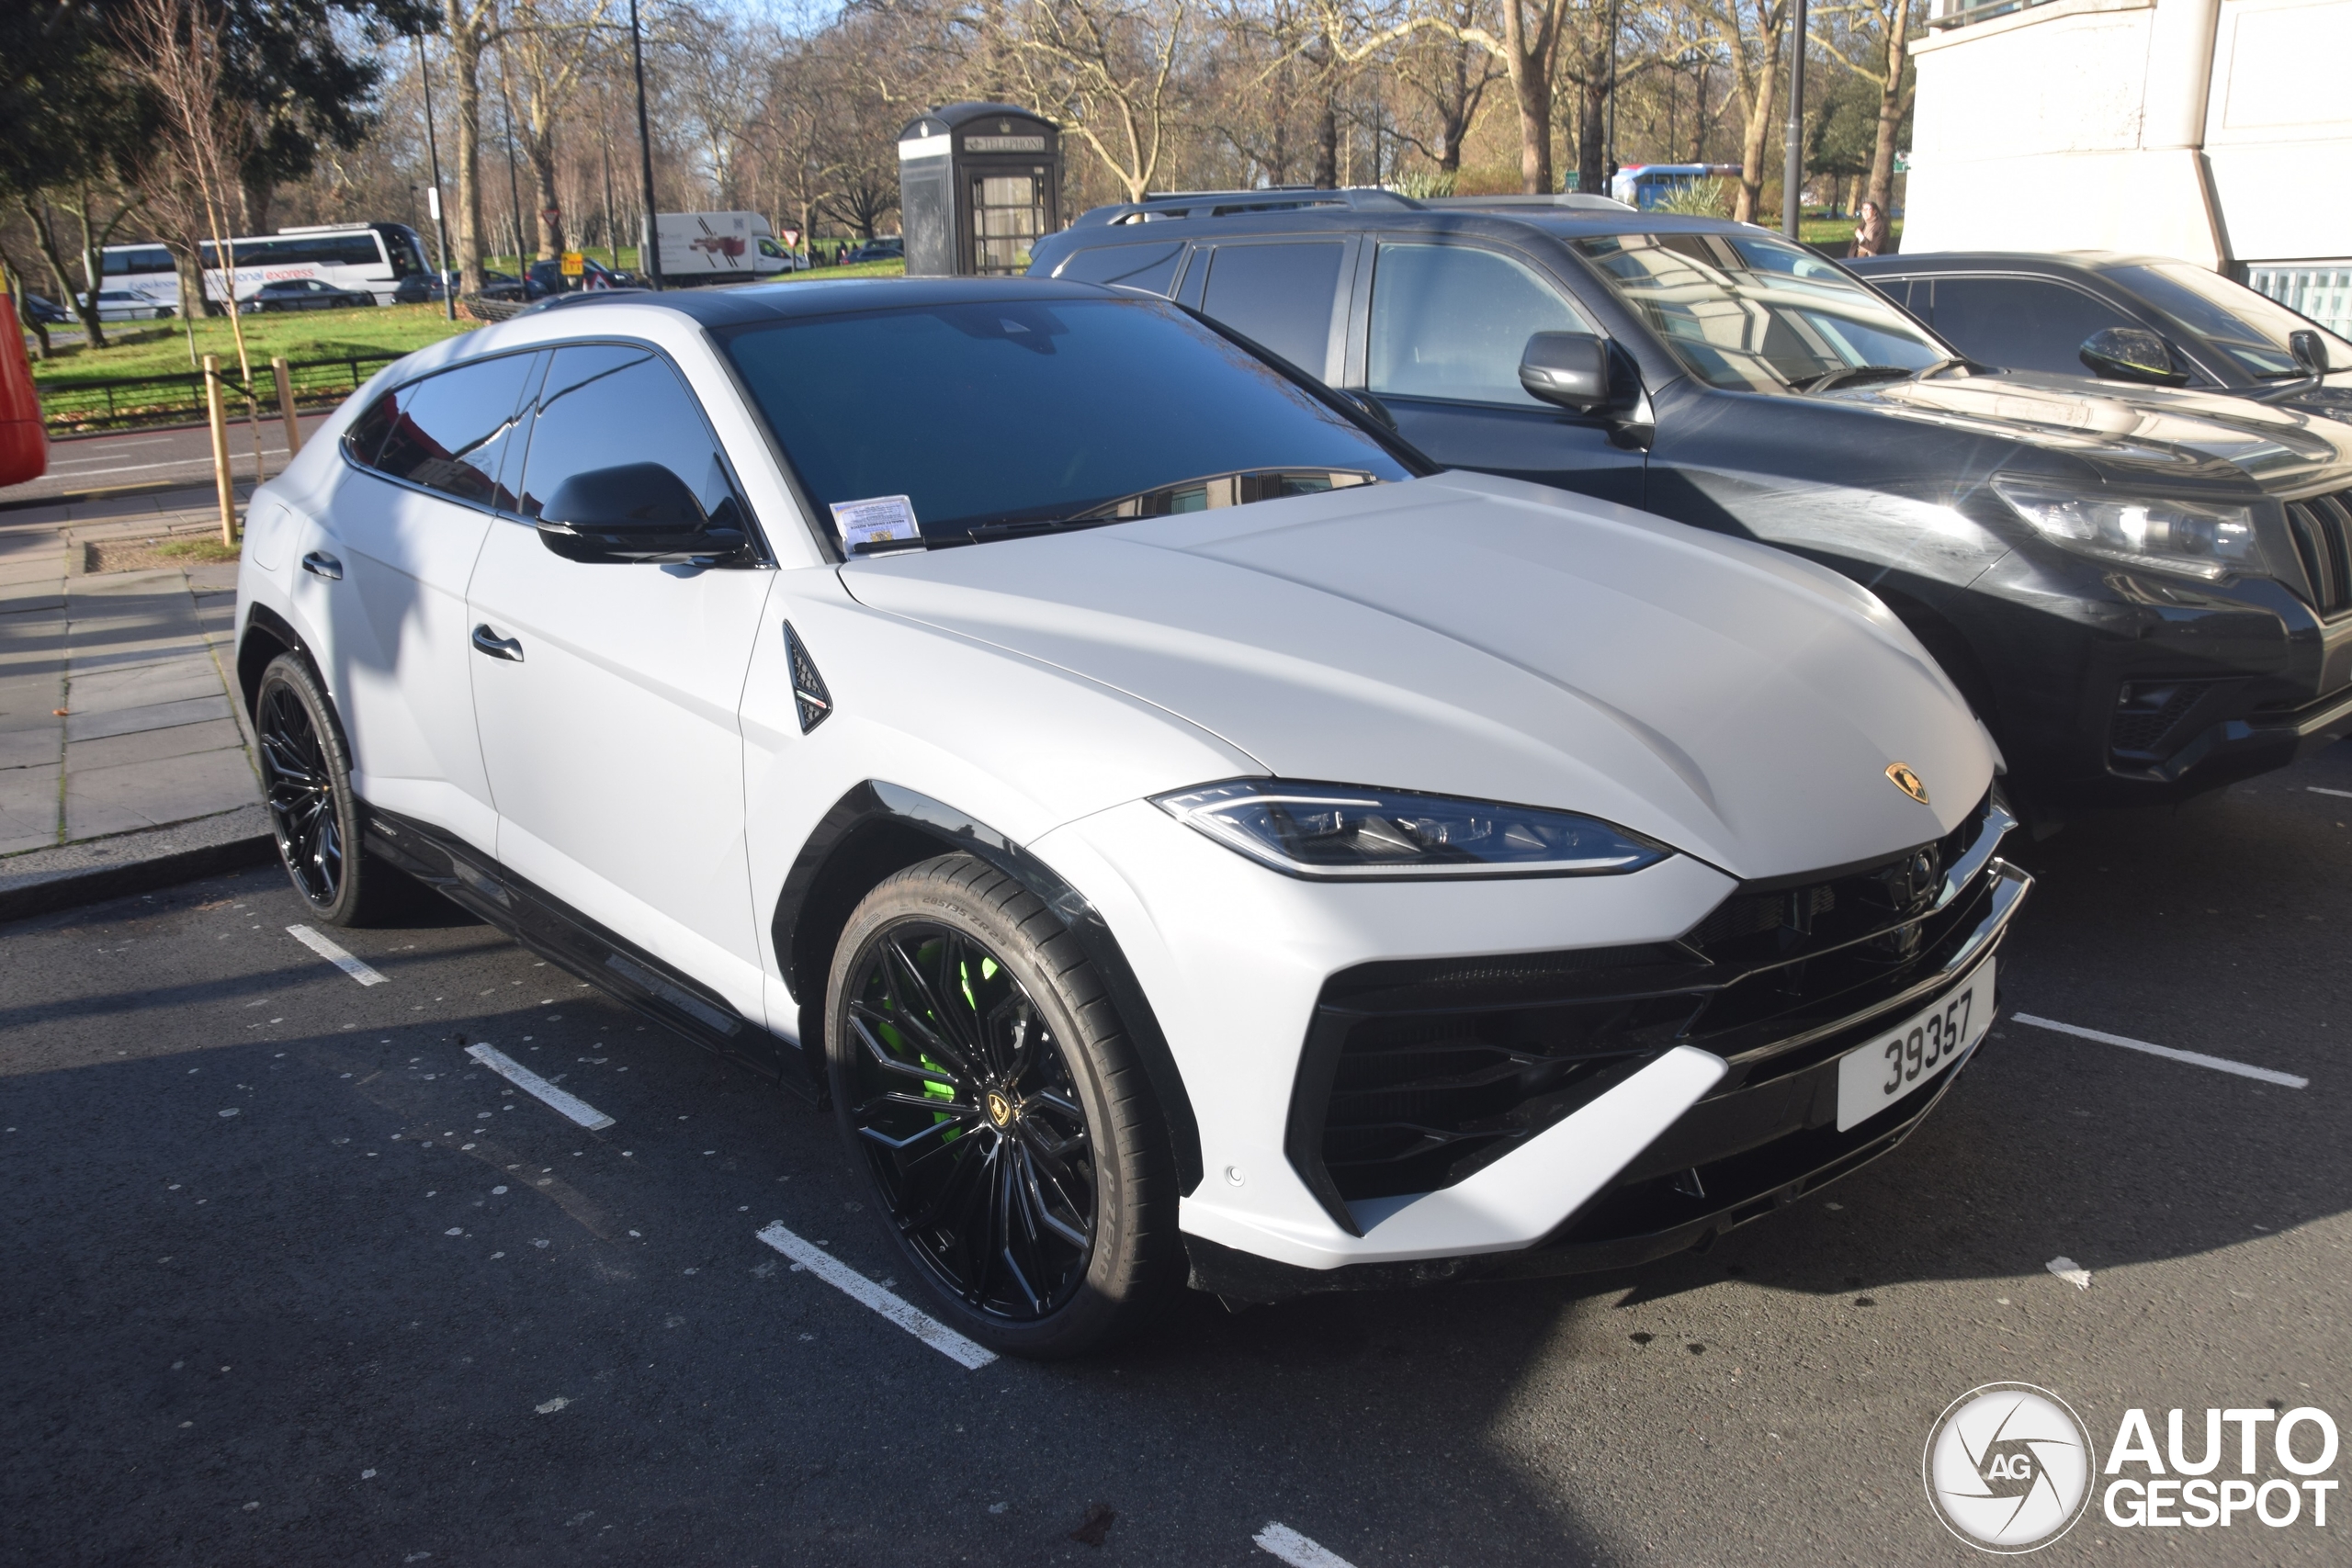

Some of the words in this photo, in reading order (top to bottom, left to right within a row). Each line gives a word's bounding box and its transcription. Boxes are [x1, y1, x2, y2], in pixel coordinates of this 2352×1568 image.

[984, 138, 1045, 150] TELEPHONE
[215, 268, 265, 282] nional
[266, 268, 314, 281] express
[922, 896, 968, 917] 285/35
[968, 915, 990, 932] ZR
[988, 931, 1007, 946] 23
[1883, 987, 1973, 1095] 39357
[1104, 1168, 1115, 1192] P
[1099, 1199, 1115, 1281] ZERO
